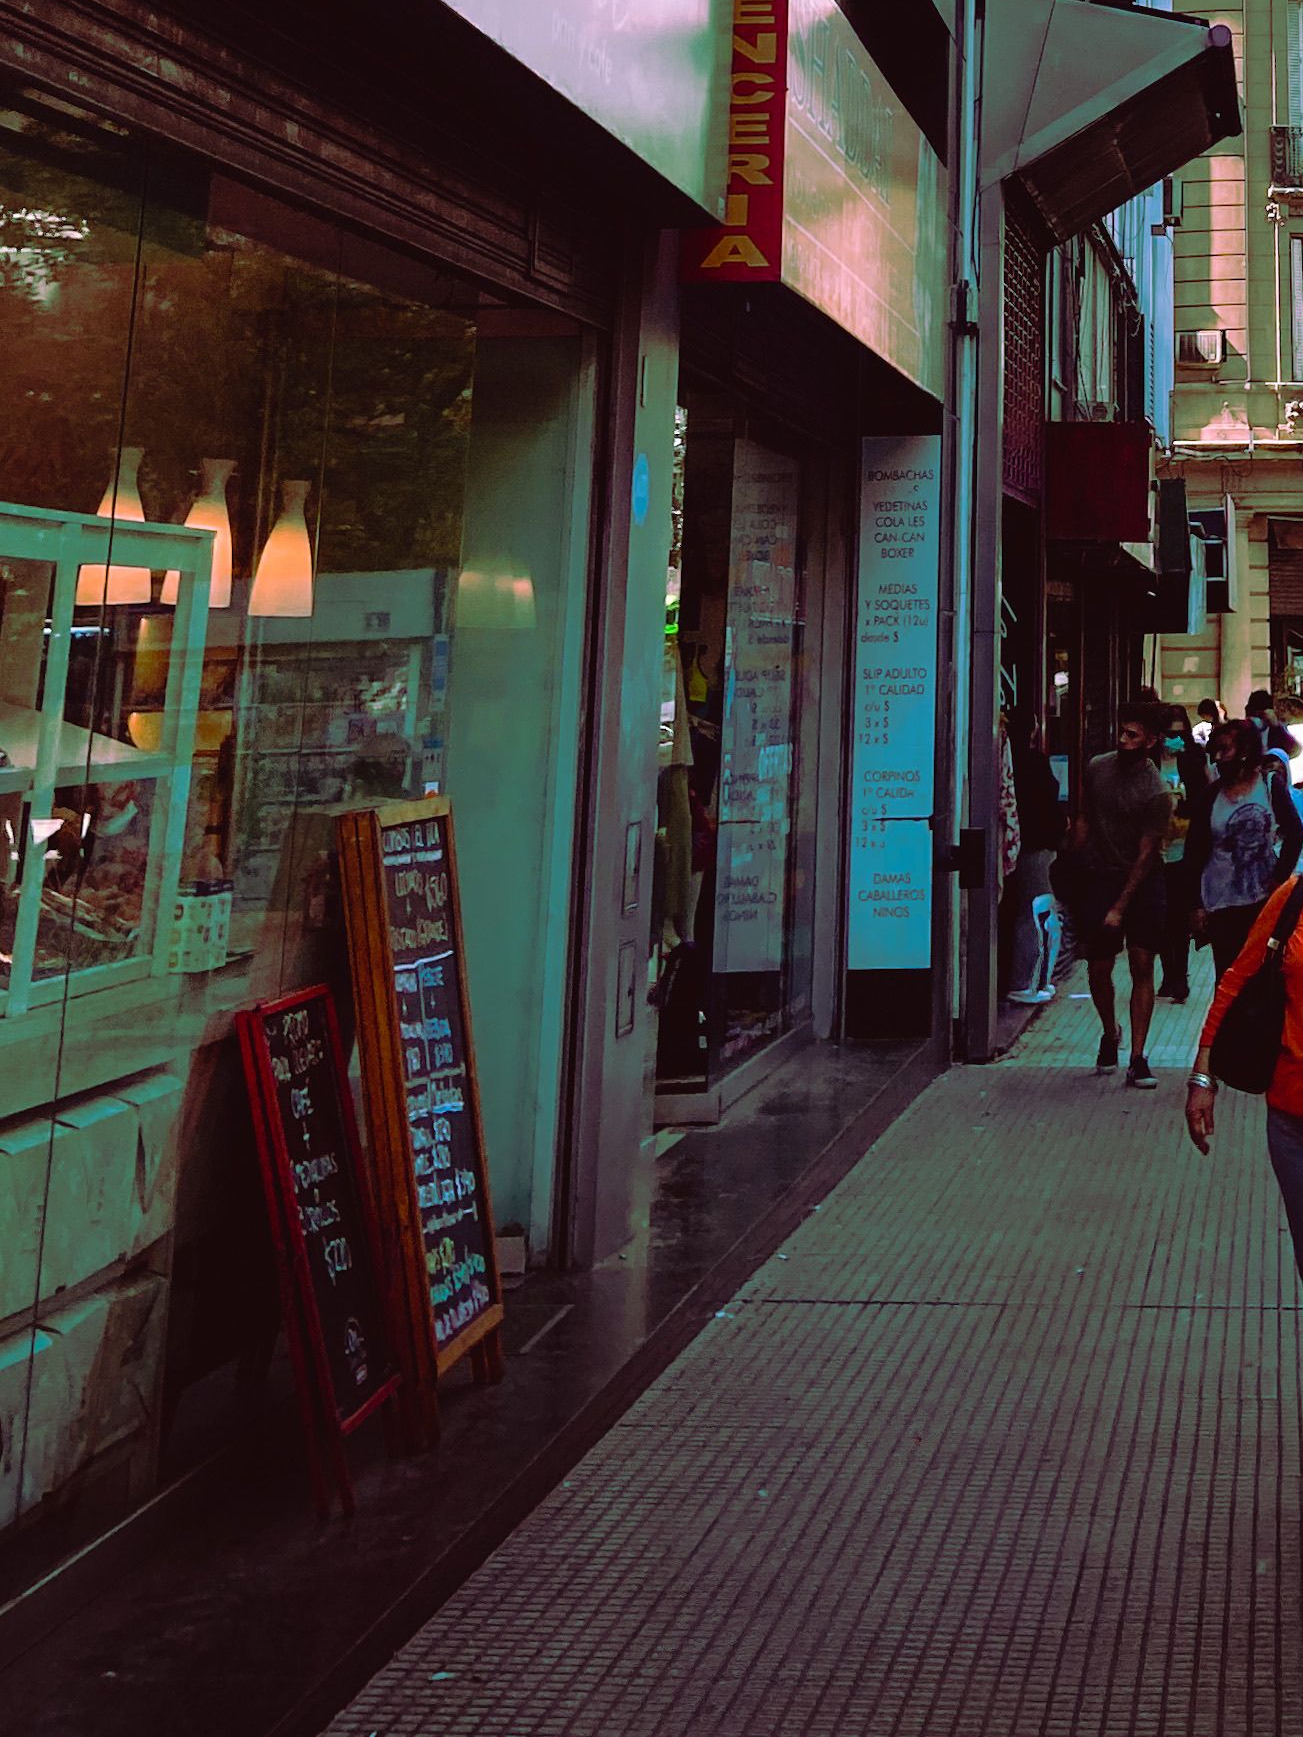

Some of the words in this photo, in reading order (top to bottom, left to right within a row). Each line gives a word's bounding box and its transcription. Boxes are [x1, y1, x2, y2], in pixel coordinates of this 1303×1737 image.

[868, 469, 934, 482] BOMBACHAS
[875, 516, 905, 528] COLA
[881, 547, 915, 559] BOXER
[878, 583, 918, 595] MEDIAS
[874, 599, 931, 612] SOQUETES
[873, 615, 900, 627] PACK
[884, 667, 928, 680] ADULTO
[878, 683, 926, 696] CALIDAD
[873, 873, 911, 885] DAMAS
[858, 889, 925, 902] CABALLEROS
